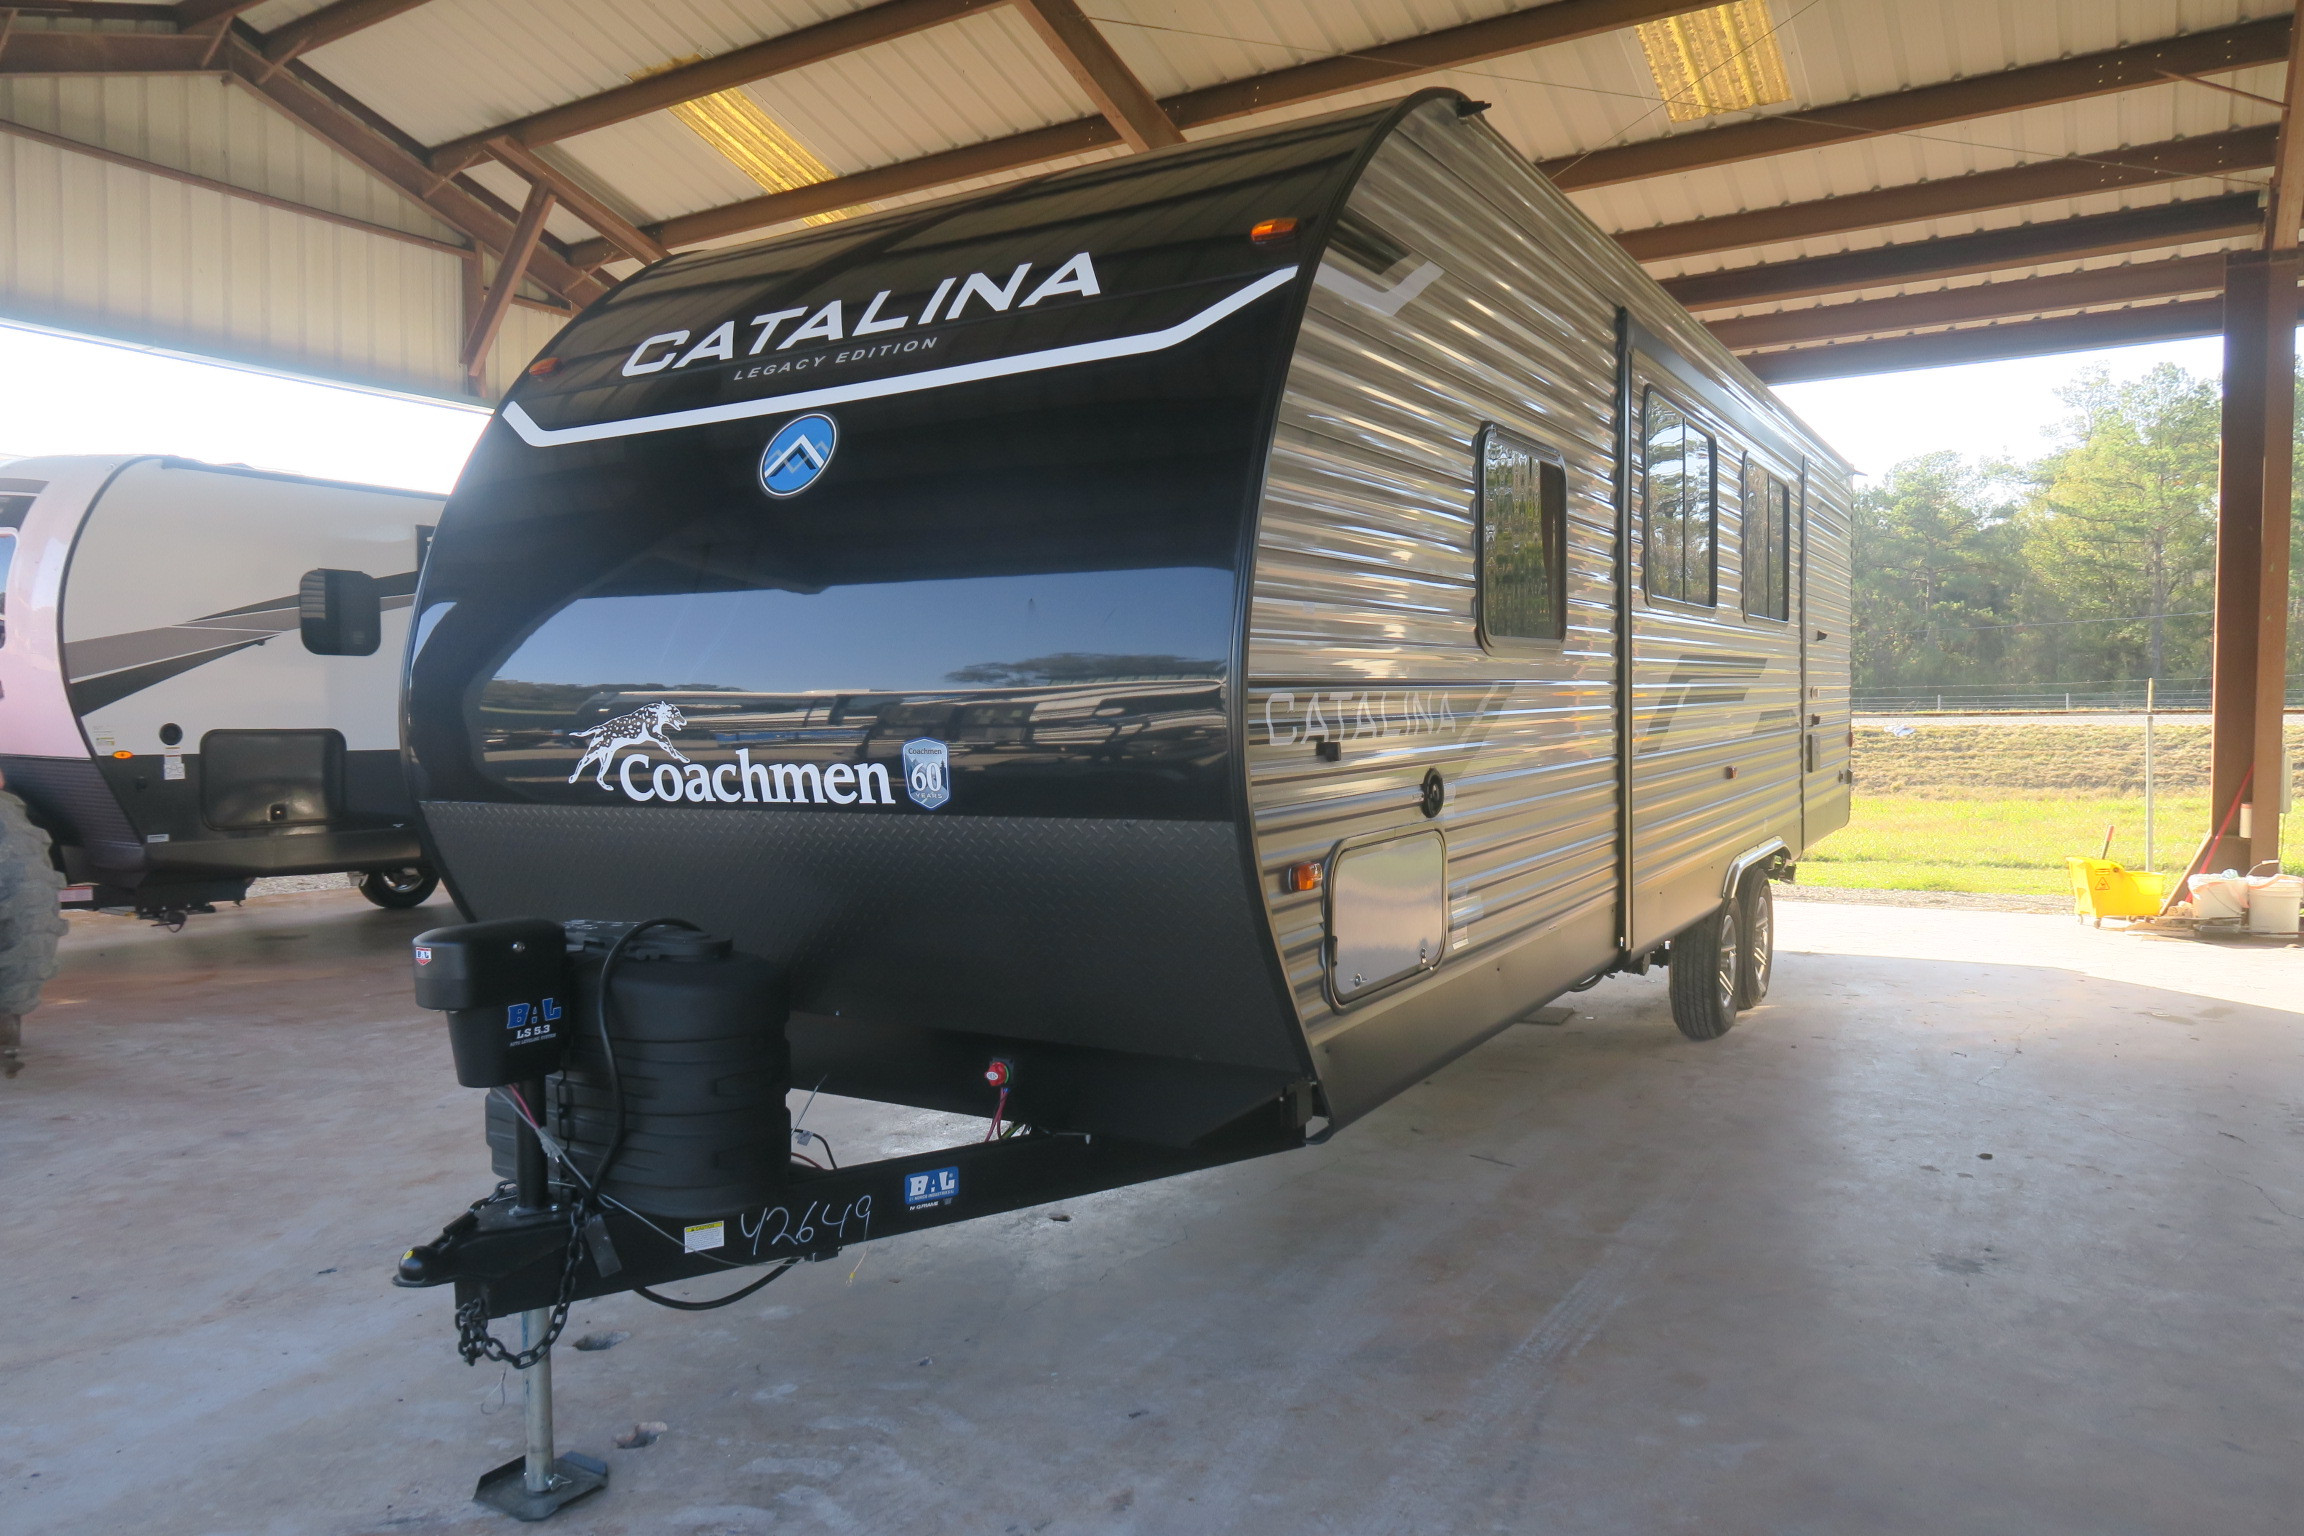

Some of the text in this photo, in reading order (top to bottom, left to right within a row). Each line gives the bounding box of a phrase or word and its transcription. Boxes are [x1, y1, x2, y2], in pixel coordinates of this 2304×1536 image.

[622, 252, 1101, 377] CATALINA
[733, 337, 939, 381] LEGACY EDITION
[1265, 690, 1456, 747] CATALINA
[908, 747, 942, 755] Coachmen
[619, 747, 896, 805] Coachmen
[911, 762, 942, 792] 60
[516, 1024, 551, 1039] LS 5.3
[909, 1171, 956, 1197] BAL
